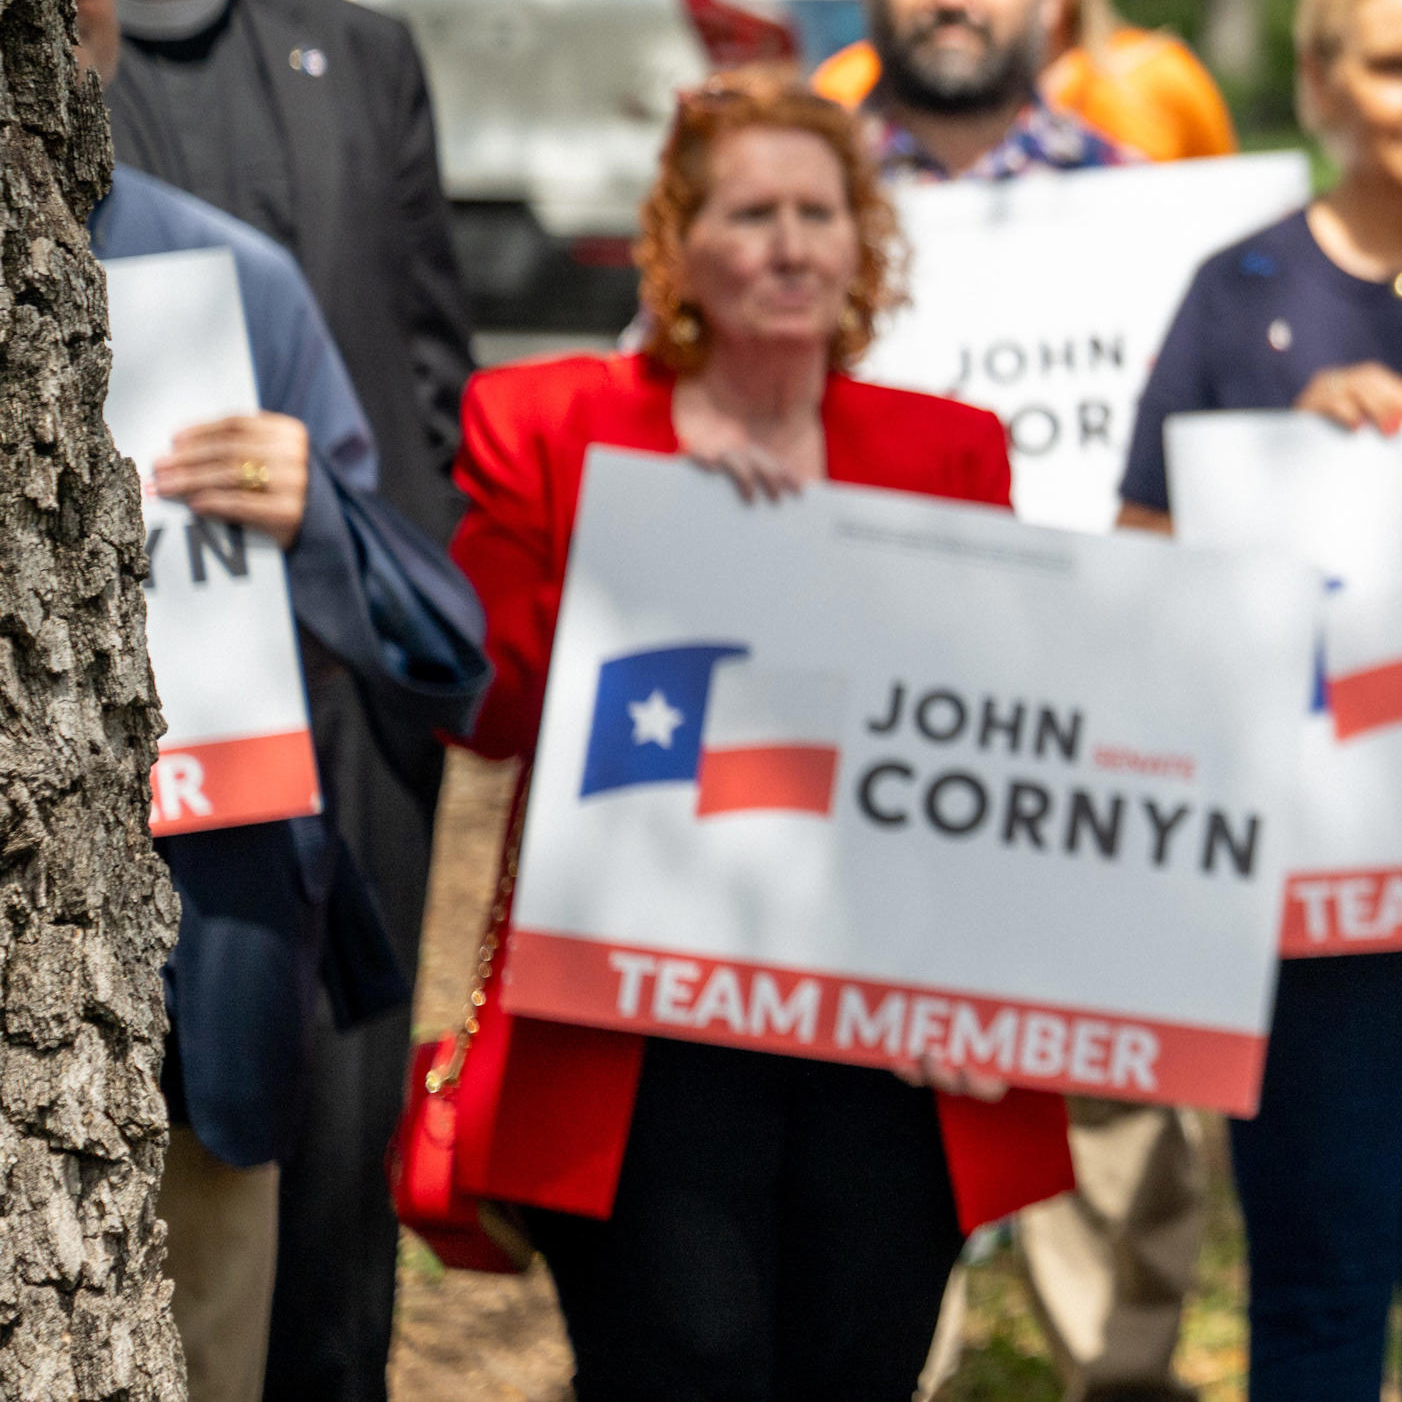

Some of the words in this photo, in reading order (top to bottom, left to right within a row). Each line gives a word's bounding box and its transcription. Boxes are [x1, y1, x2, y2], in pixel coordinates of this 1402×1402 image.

[956, 332, 1126, 384] JOHN
[866, 680, 1086, 766] JOHN
[857, 761, 1264, 883] CORNYN
[609, 951, 819, 1046] TEAM
[834, 988, 1160, 1093] MEMBER
